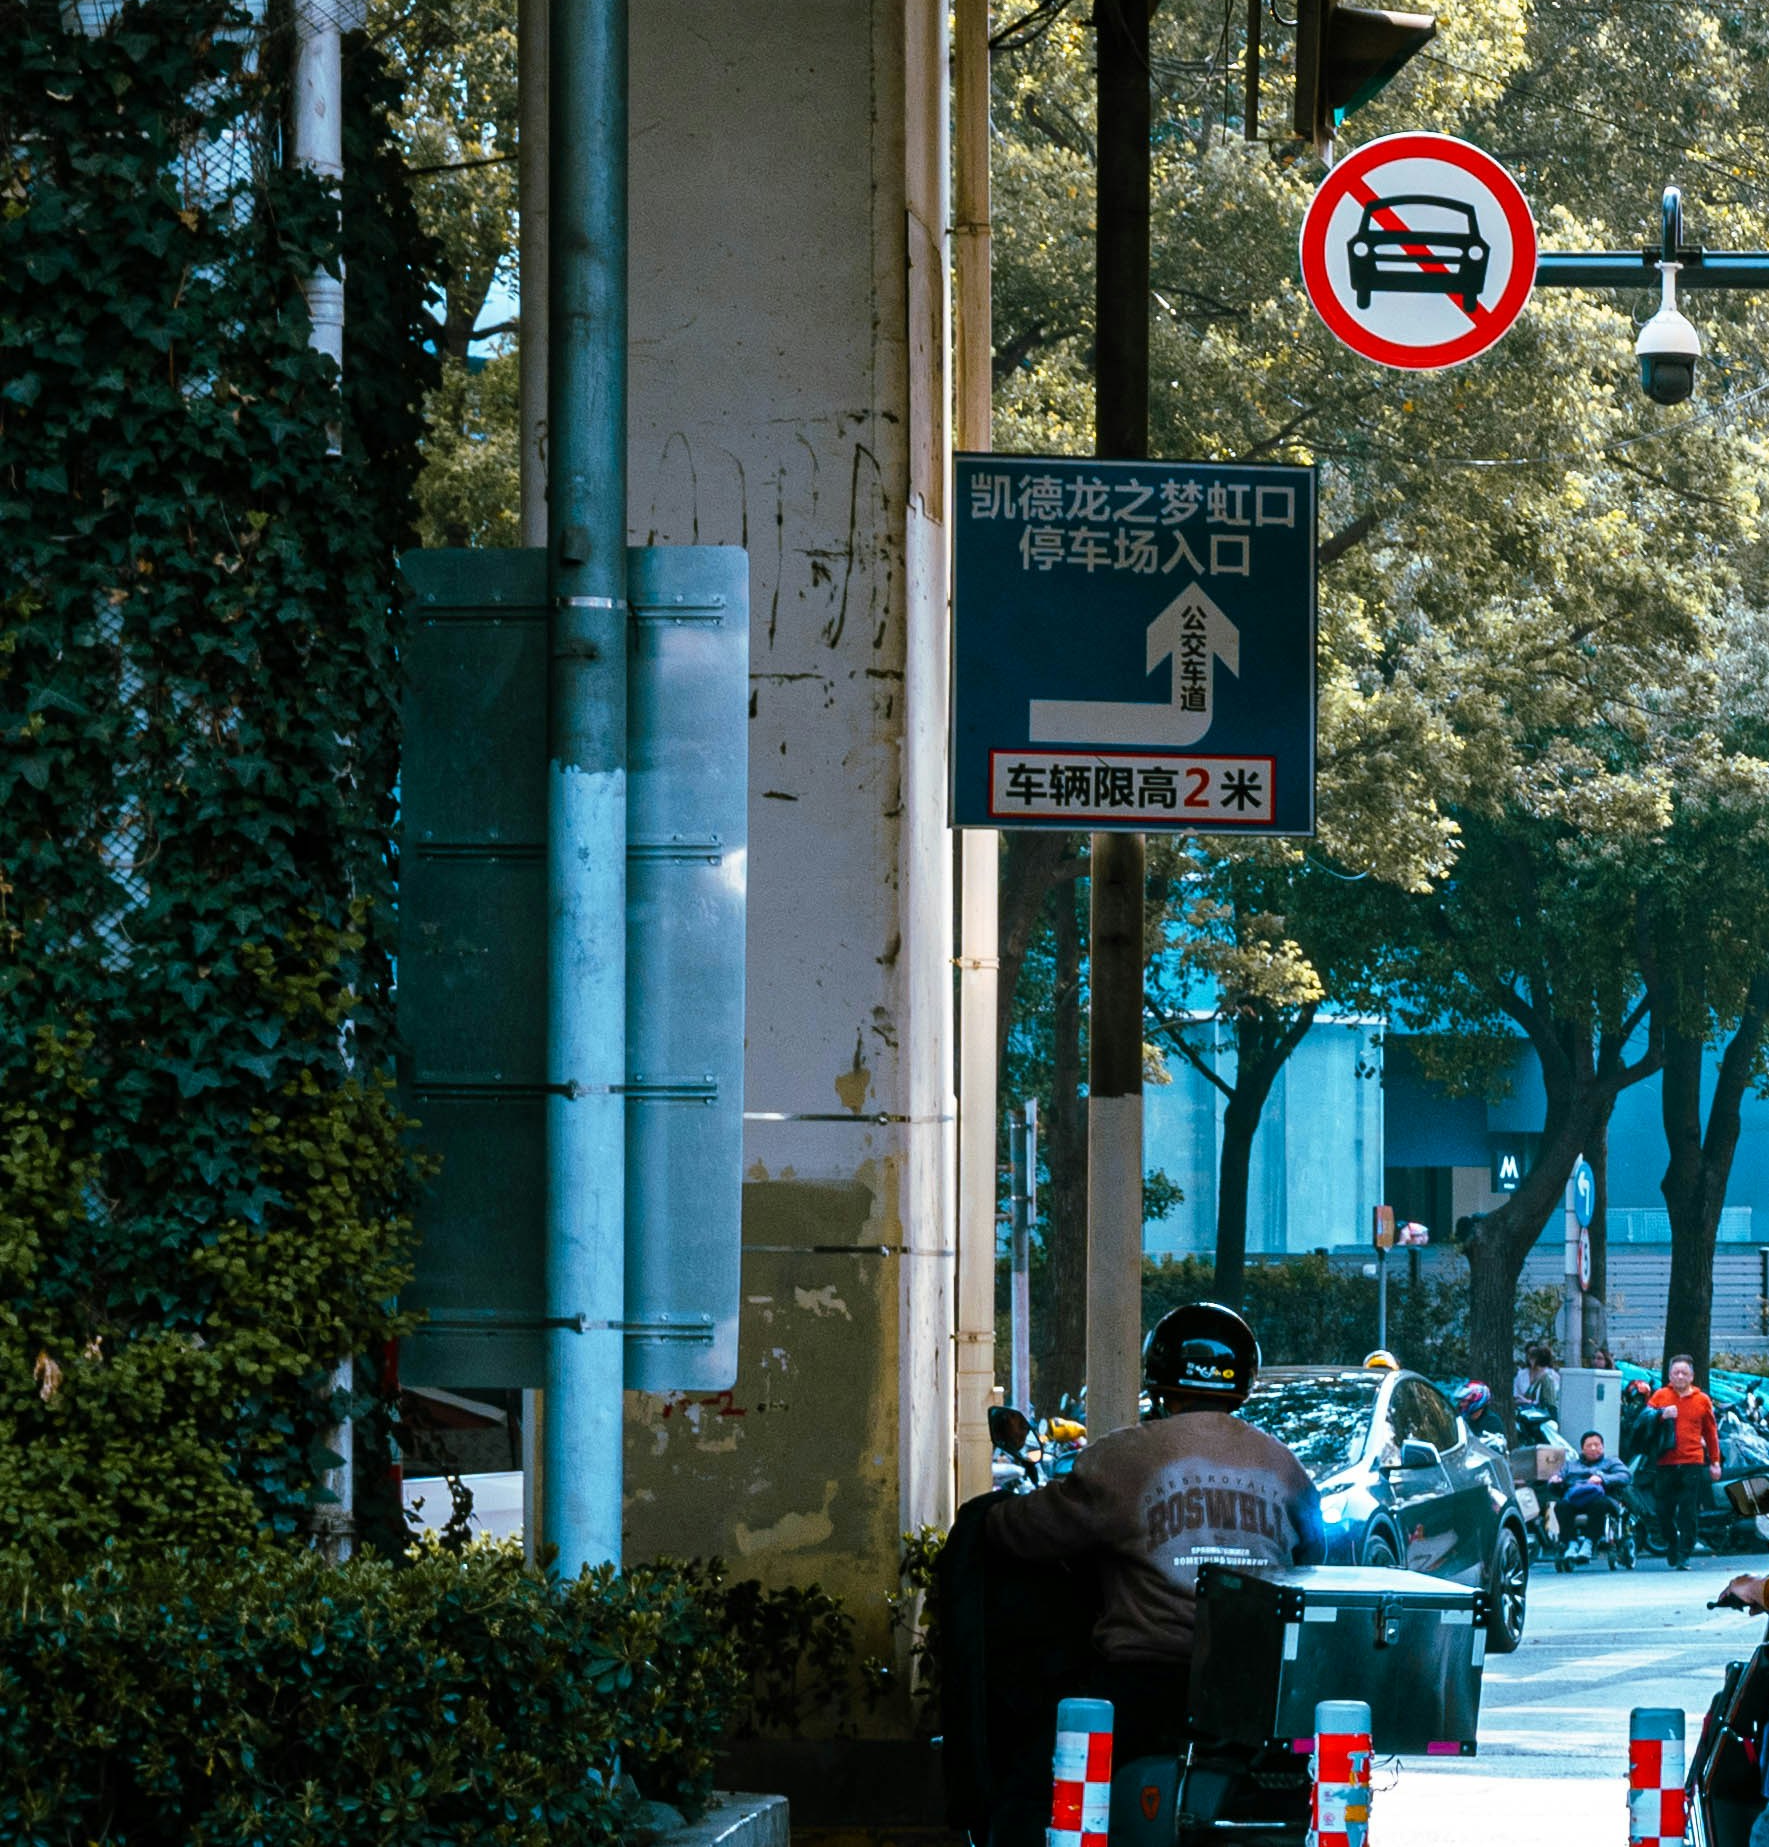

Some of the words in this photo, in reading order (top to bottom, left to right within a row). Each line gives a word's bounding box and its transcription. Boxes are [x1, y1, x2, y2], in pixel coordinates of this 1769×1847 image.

[970, 472, 1296, 529] 凯德龙之梦虹口
[1018, 523, 1251, 577] 停车场入口
[1179, 604, 1208, 713] 公交车道
